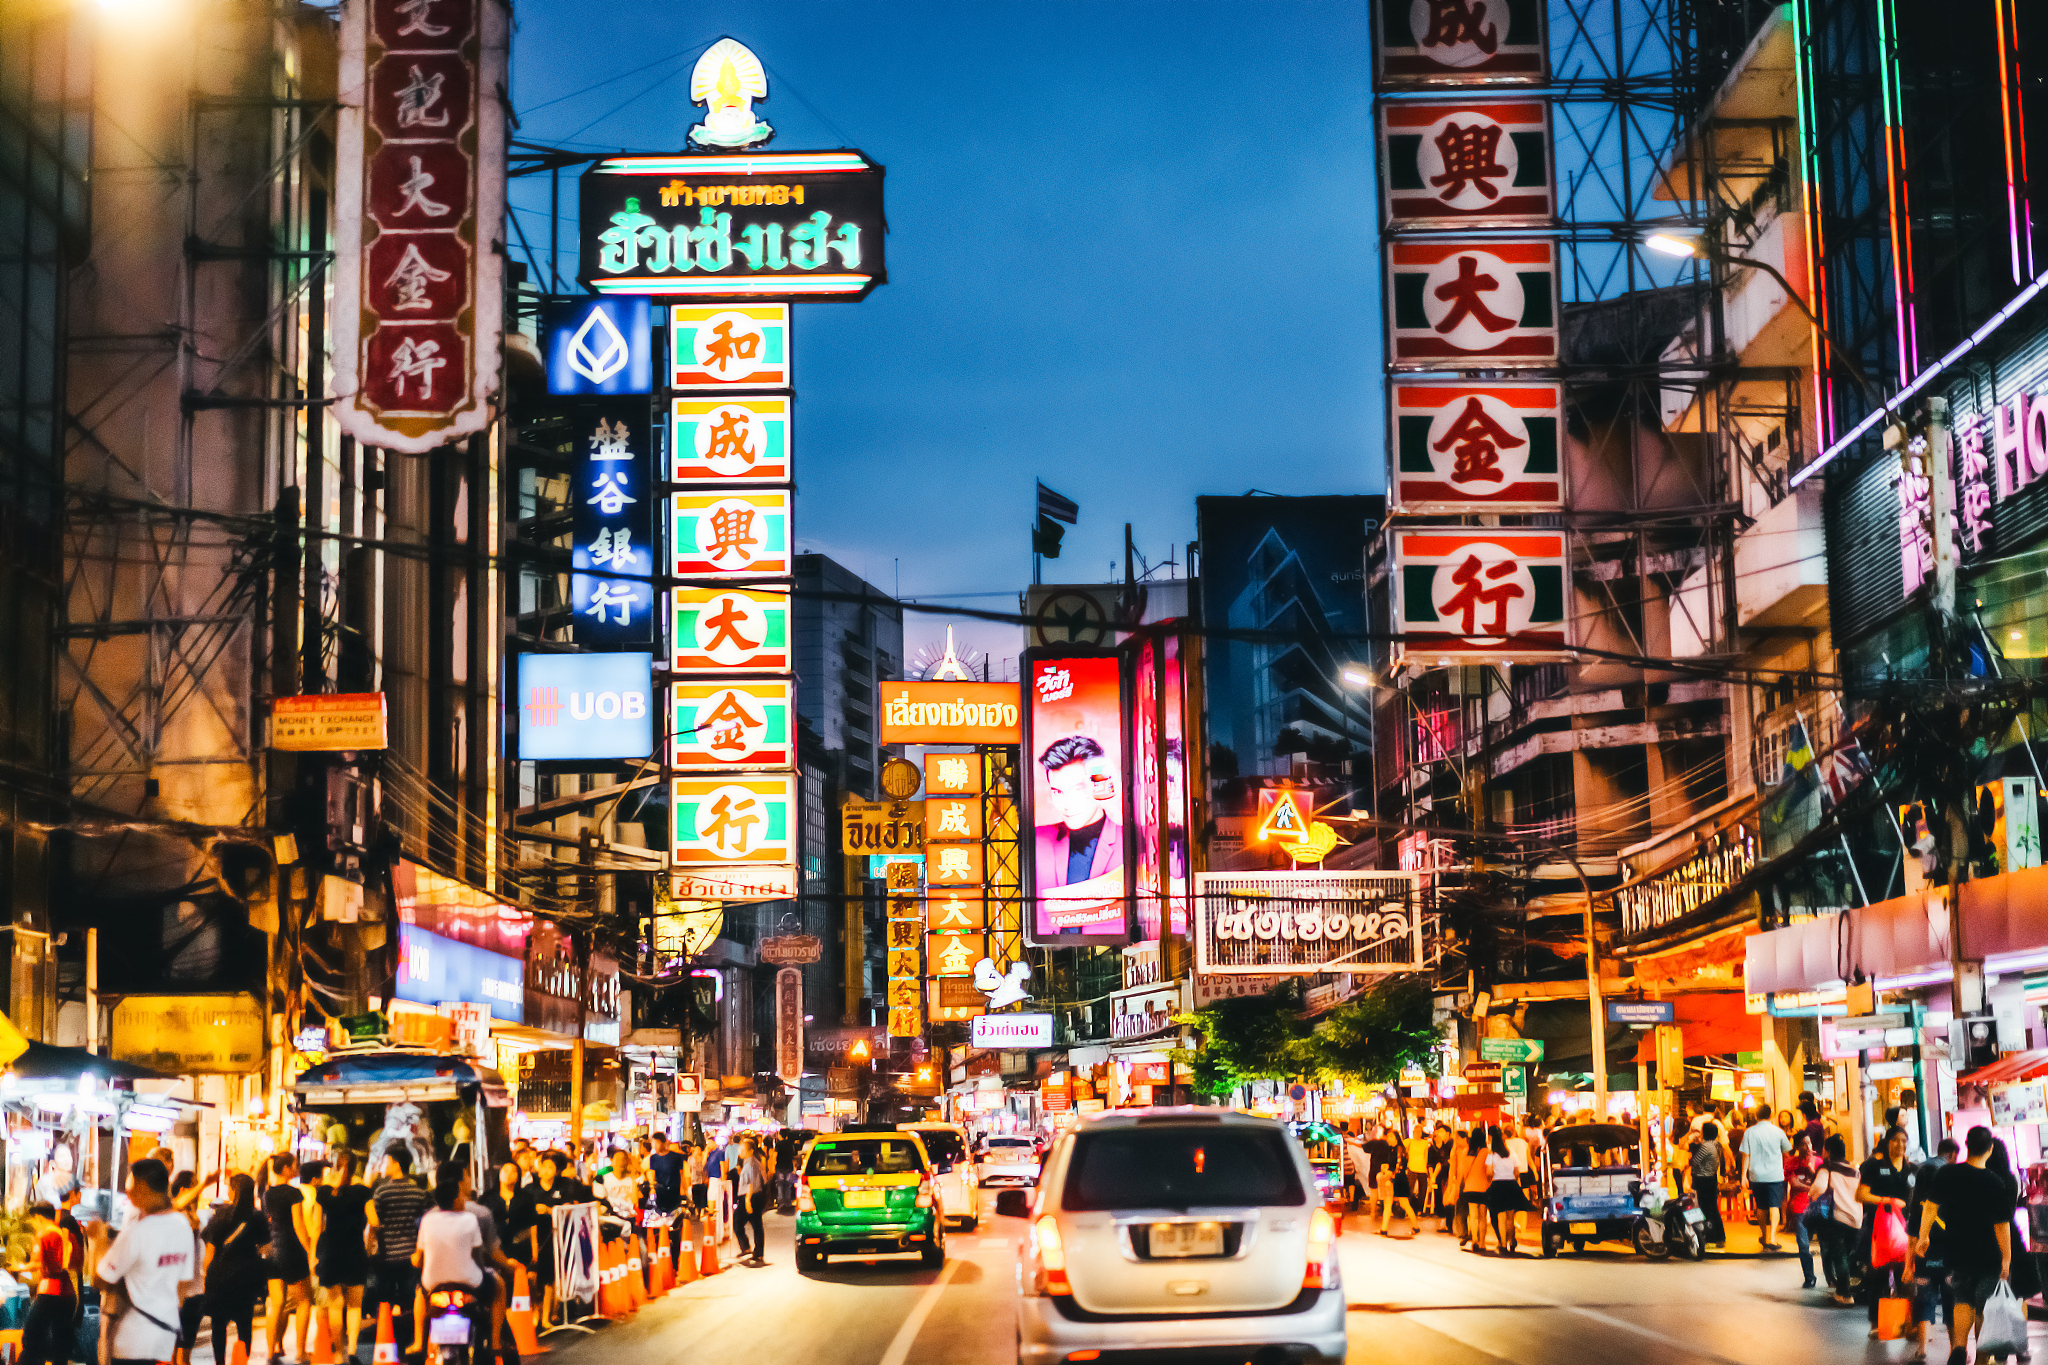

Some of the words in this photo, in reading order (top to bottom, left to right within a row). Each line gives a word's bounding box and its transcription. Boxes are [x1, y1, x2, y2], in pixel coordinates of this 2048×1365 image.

[659, 180, 805, 207] ห้างขายทอง
[585, 416, 639, 627] 盤谷銀行
[701, 319, 764, 853] 和成興大金行
[279, 716, 314, 725] MONEY
[320, 715, 376, 724] EXCHANGE
[570, 691, 646, 720] UOB
[885, 691, 1018, 728] เลี่ยงเซ่งเฮง
[937, 758, 974, 1018] 聯成興大金
